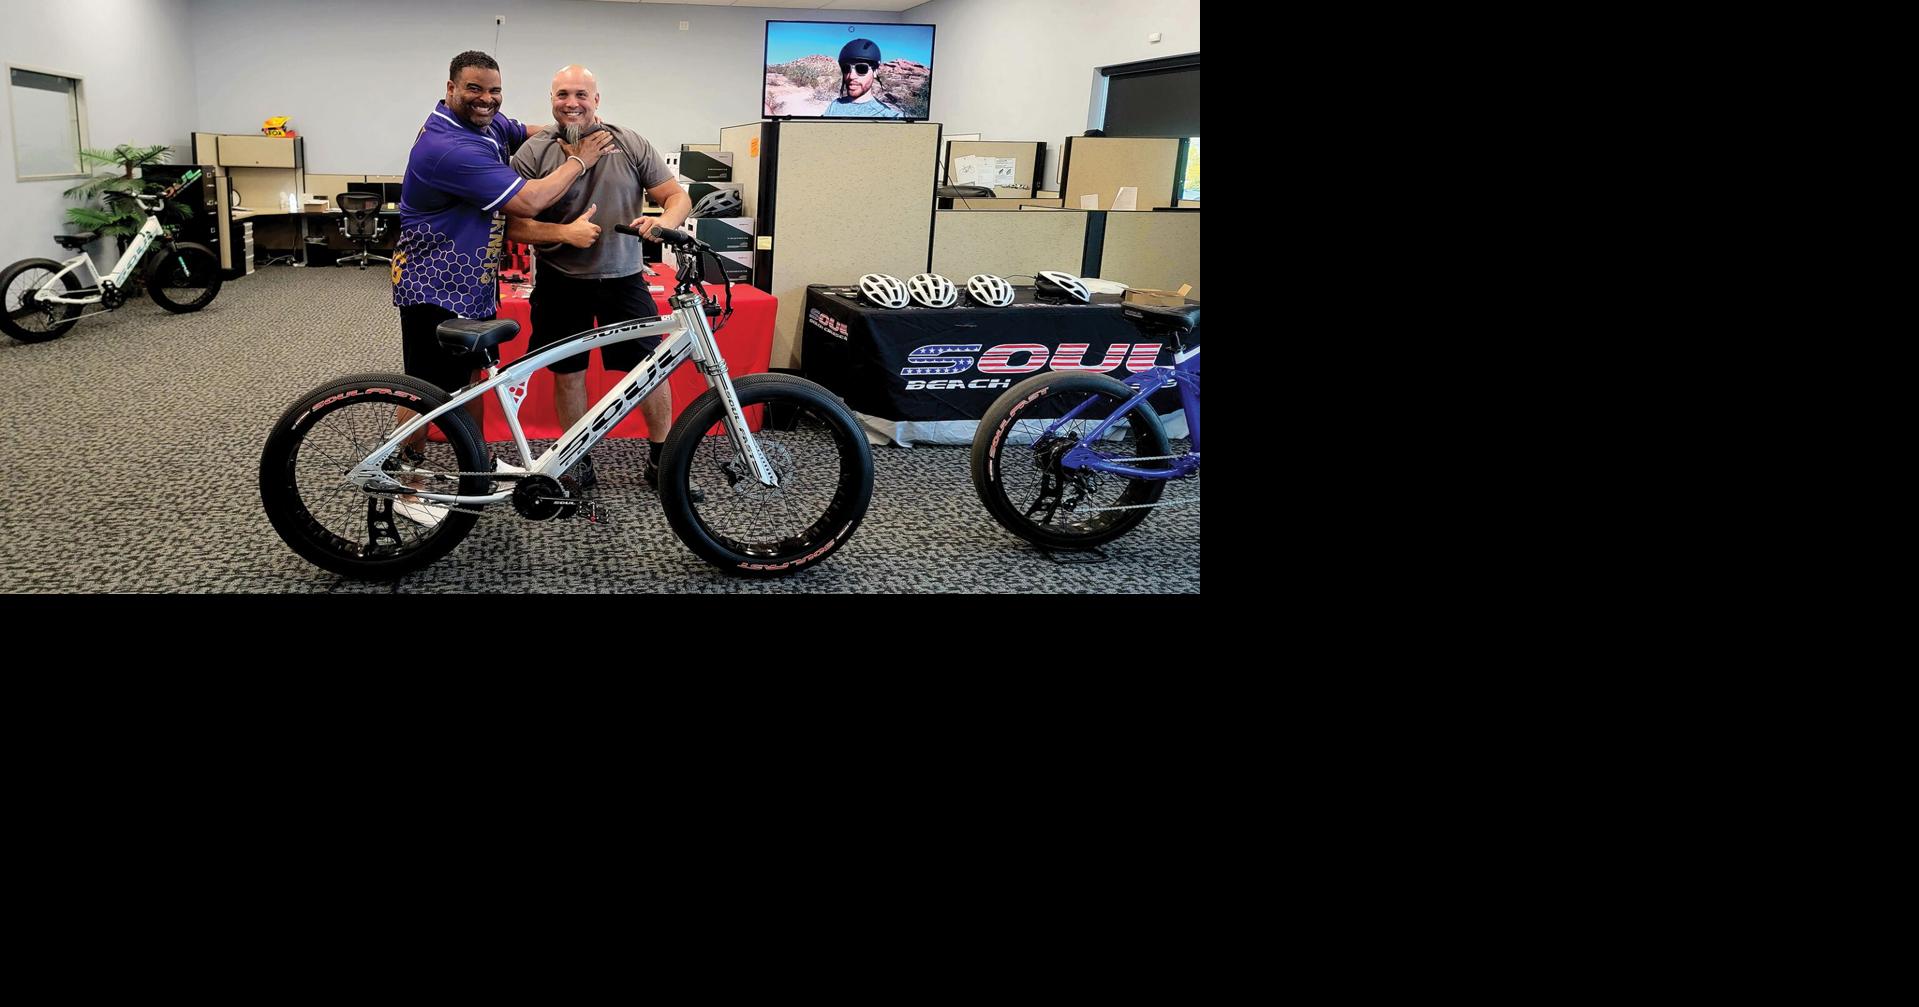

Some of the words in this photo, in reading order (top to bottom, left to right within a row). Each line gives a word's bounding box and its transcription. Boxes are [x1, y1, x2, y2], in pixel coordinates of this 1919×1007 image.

[900, 343, 1175, 375] SOUL
[904, 378, 1011, 391] BEACH
[312, 389, 364, 413] SOUL
[365, 387, 421, 402] FAST
[558, 341, 692, 467] SOUL
[989, 417, 1012, 459] SOUL
[1010, 386, 1049, 417] FAST
[737, 561, 790, 571] FAST
[789, 538, 836, 566] SOUL
